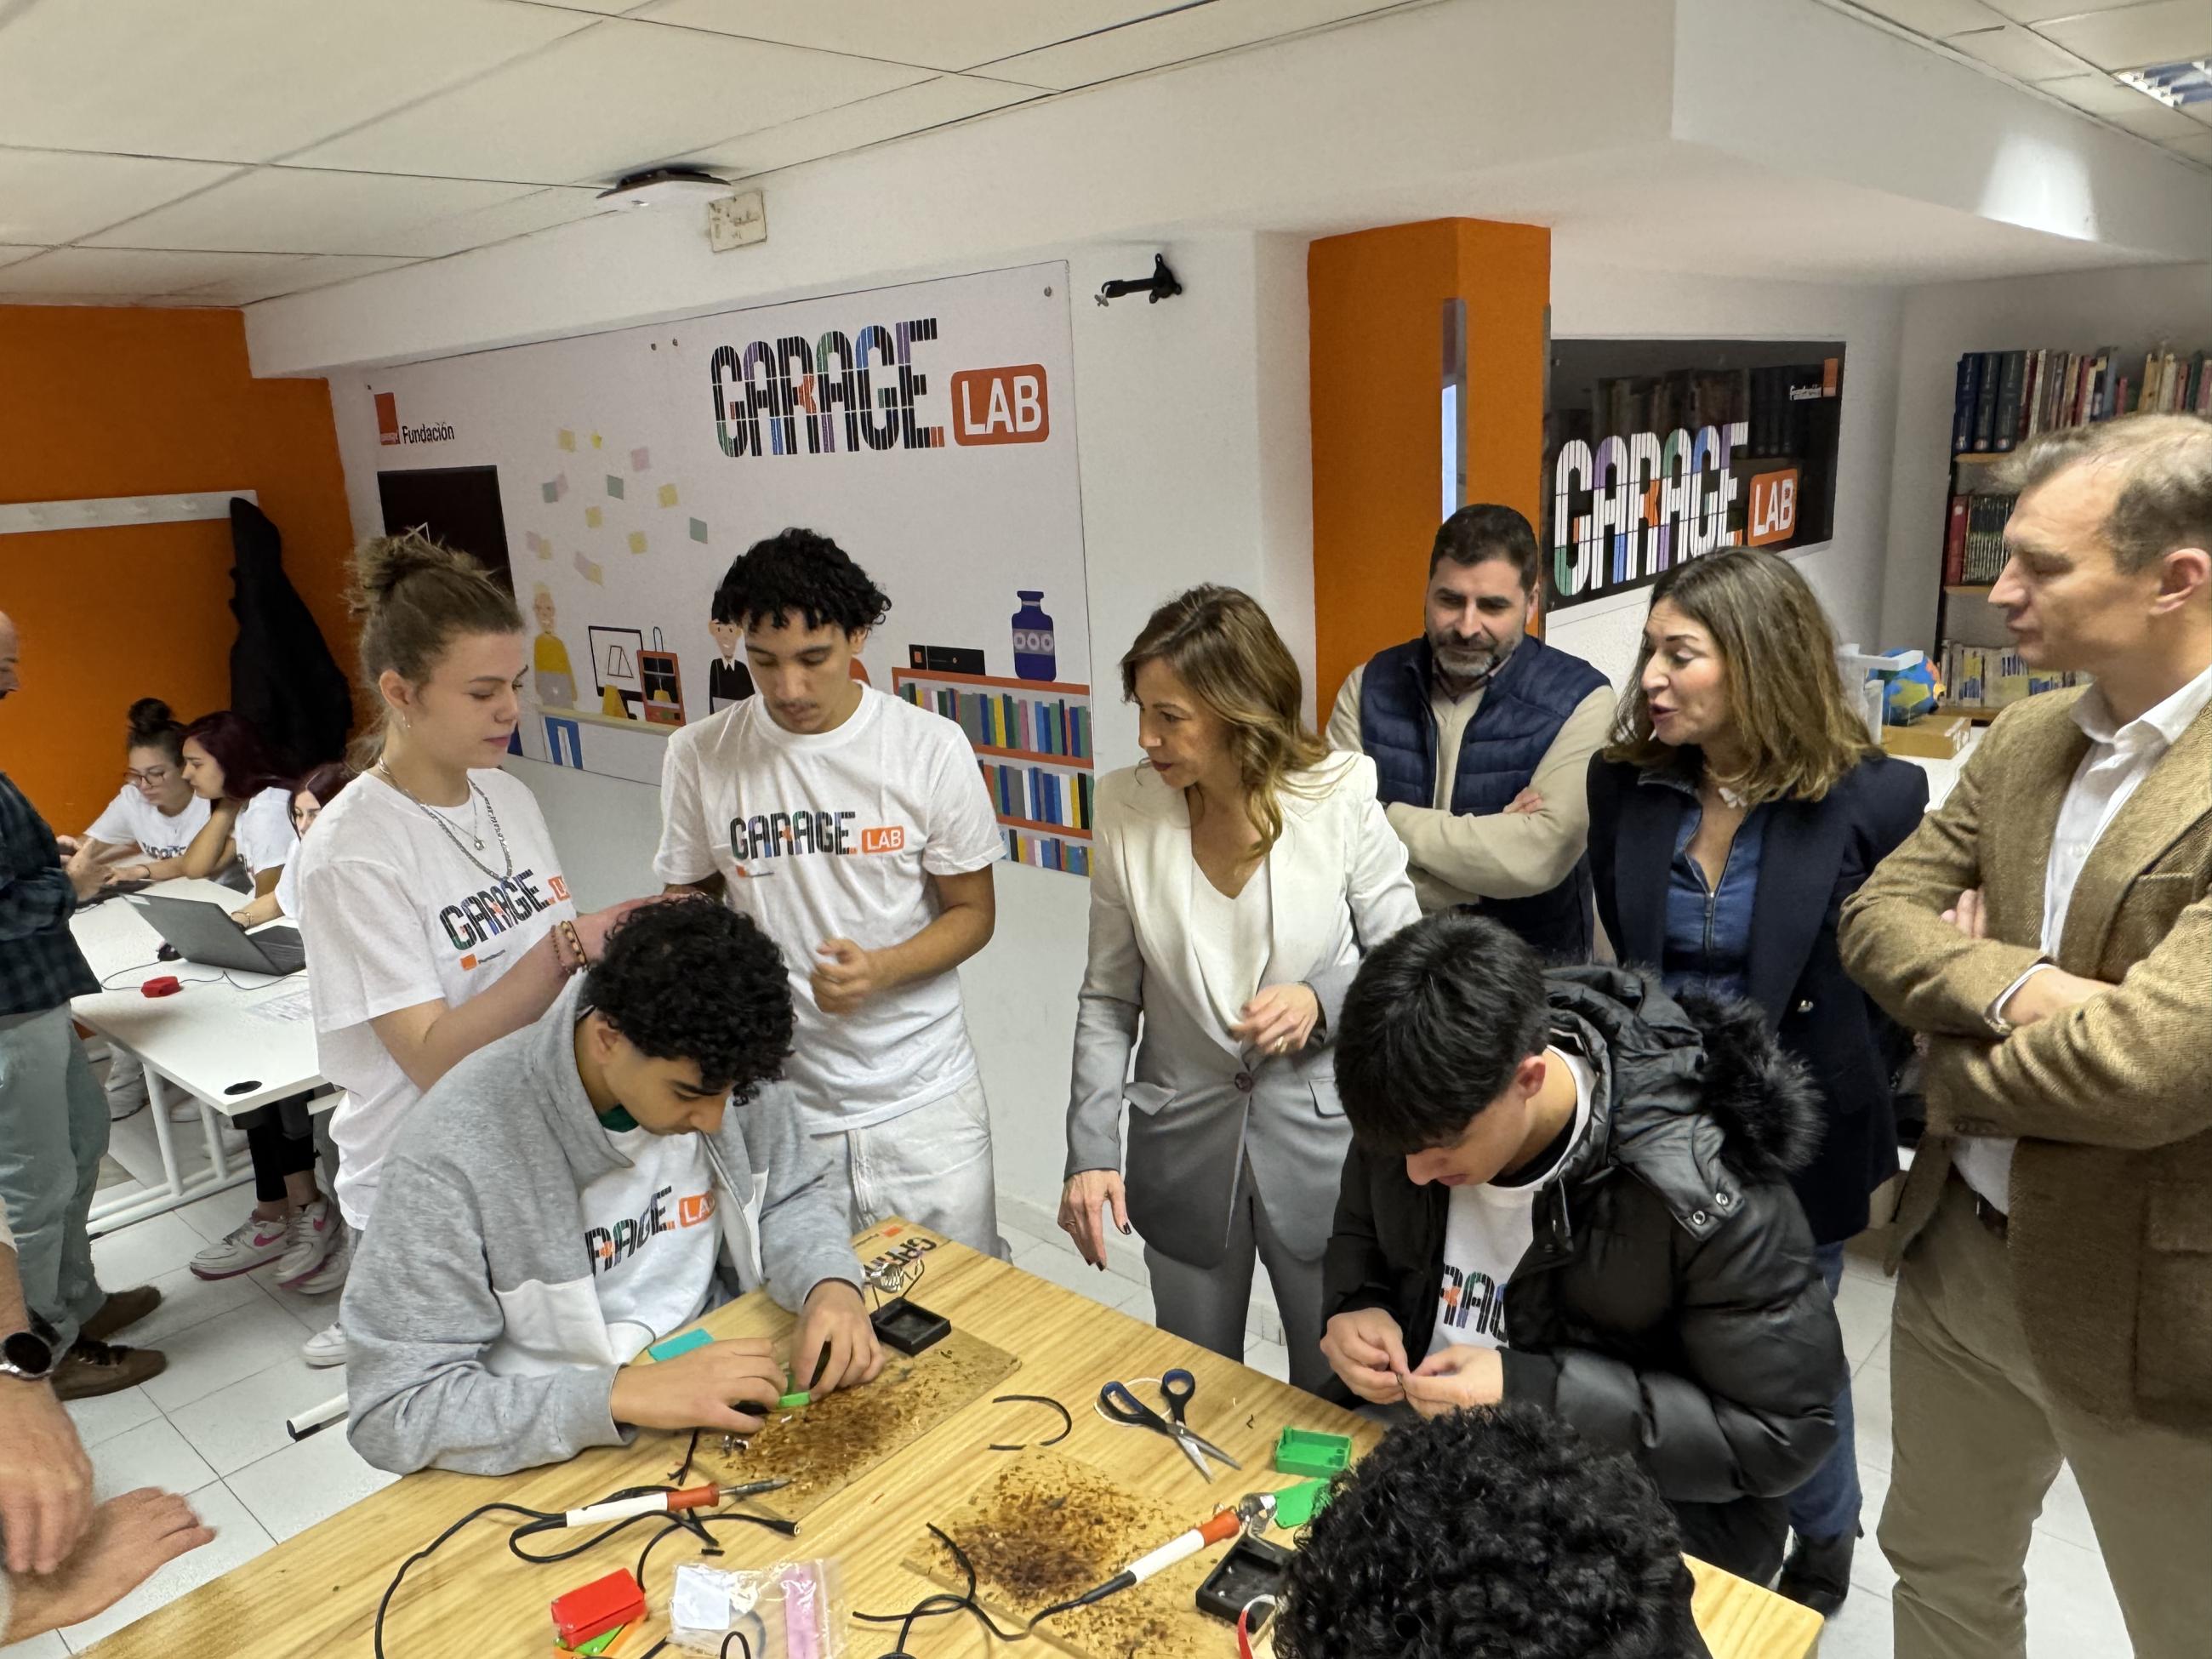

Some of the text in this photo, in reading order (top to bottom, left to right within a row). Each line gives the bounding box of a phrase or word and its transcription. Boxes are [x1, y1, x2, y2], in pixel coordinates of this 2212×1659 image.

[710, 318, 1041, 458] GARAGE LAB
[402, 421, 455, 444] Fundación
[1554, 422, 1794, 596] GARAGE LAB
[730, 810, 902, 860] GARAGE LAB
[439, 869, 556, 950] GARAGE
